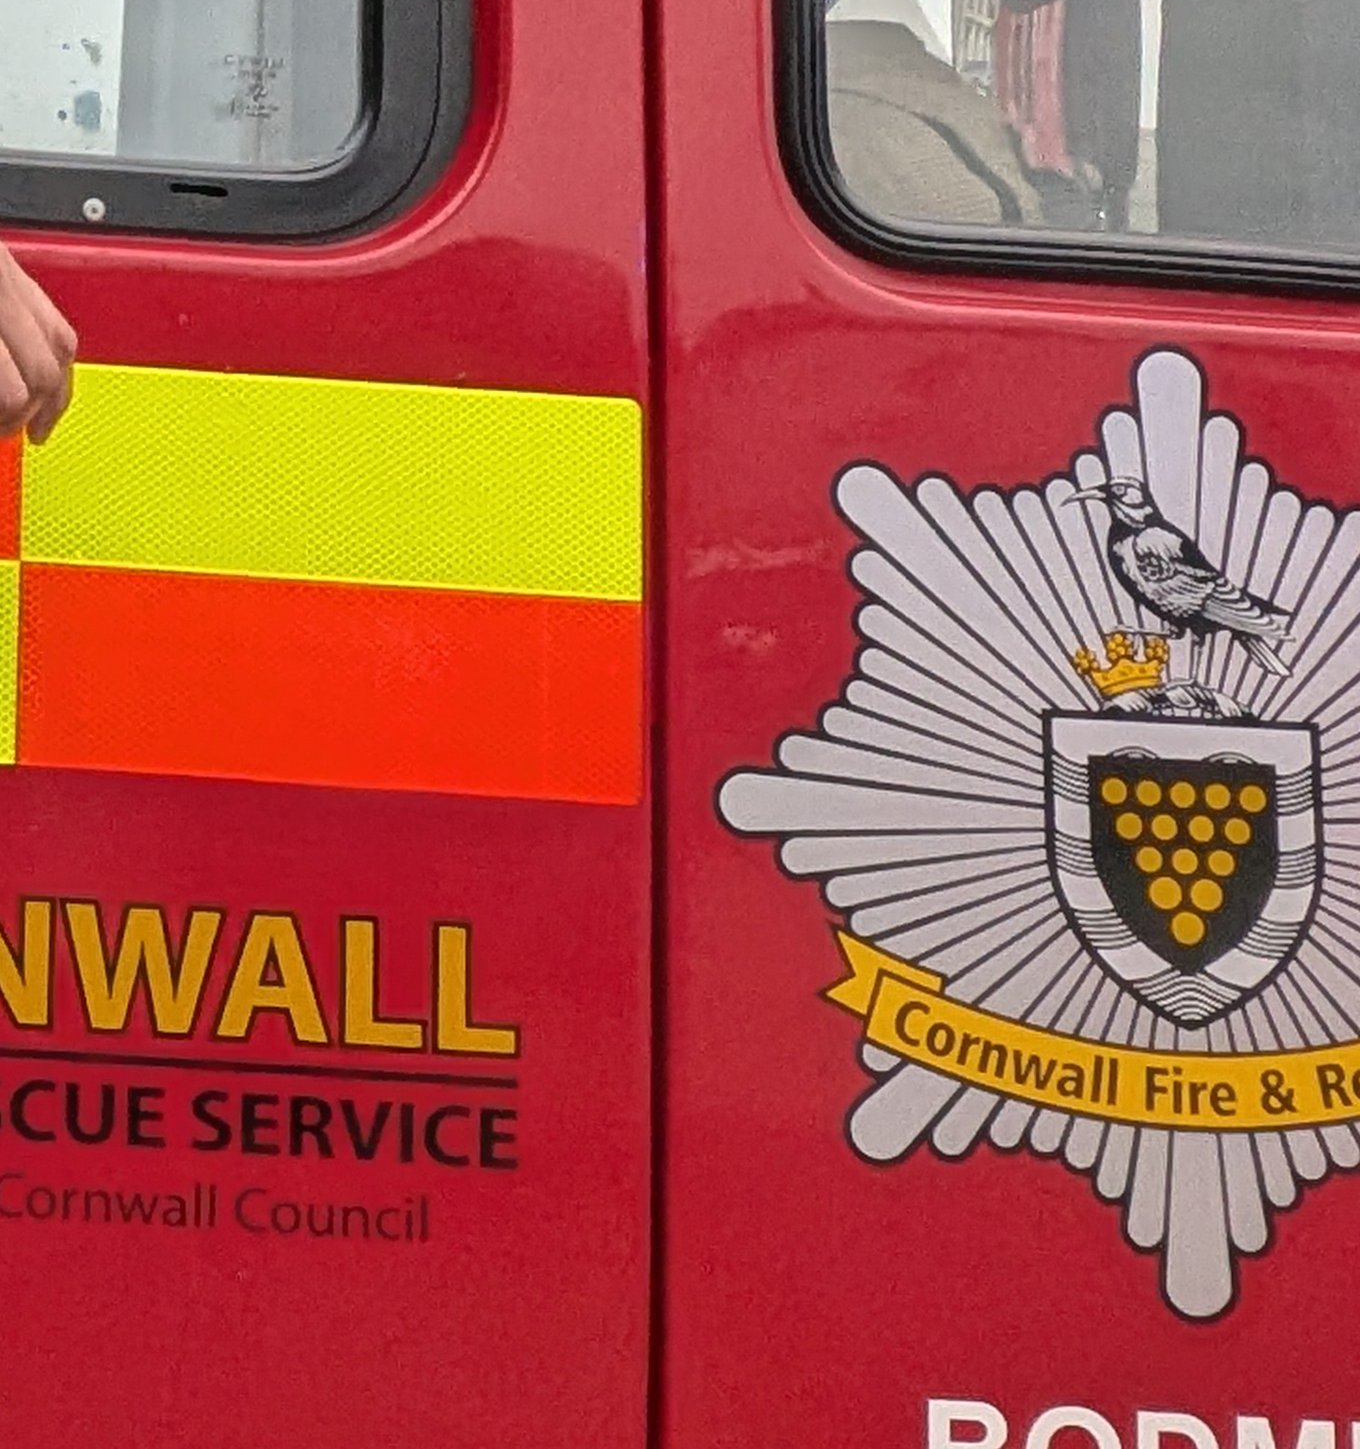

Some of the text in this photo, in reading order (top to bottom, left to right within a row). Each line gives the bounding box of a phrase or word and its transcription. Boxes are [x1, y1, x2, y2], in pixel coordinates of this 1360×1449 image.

[893, 1000, 1360, 1117] Cornwall Fire & R
[190, 1088, 519, 1171] SERVICE
[231, 1186, 431, 1244] Council
